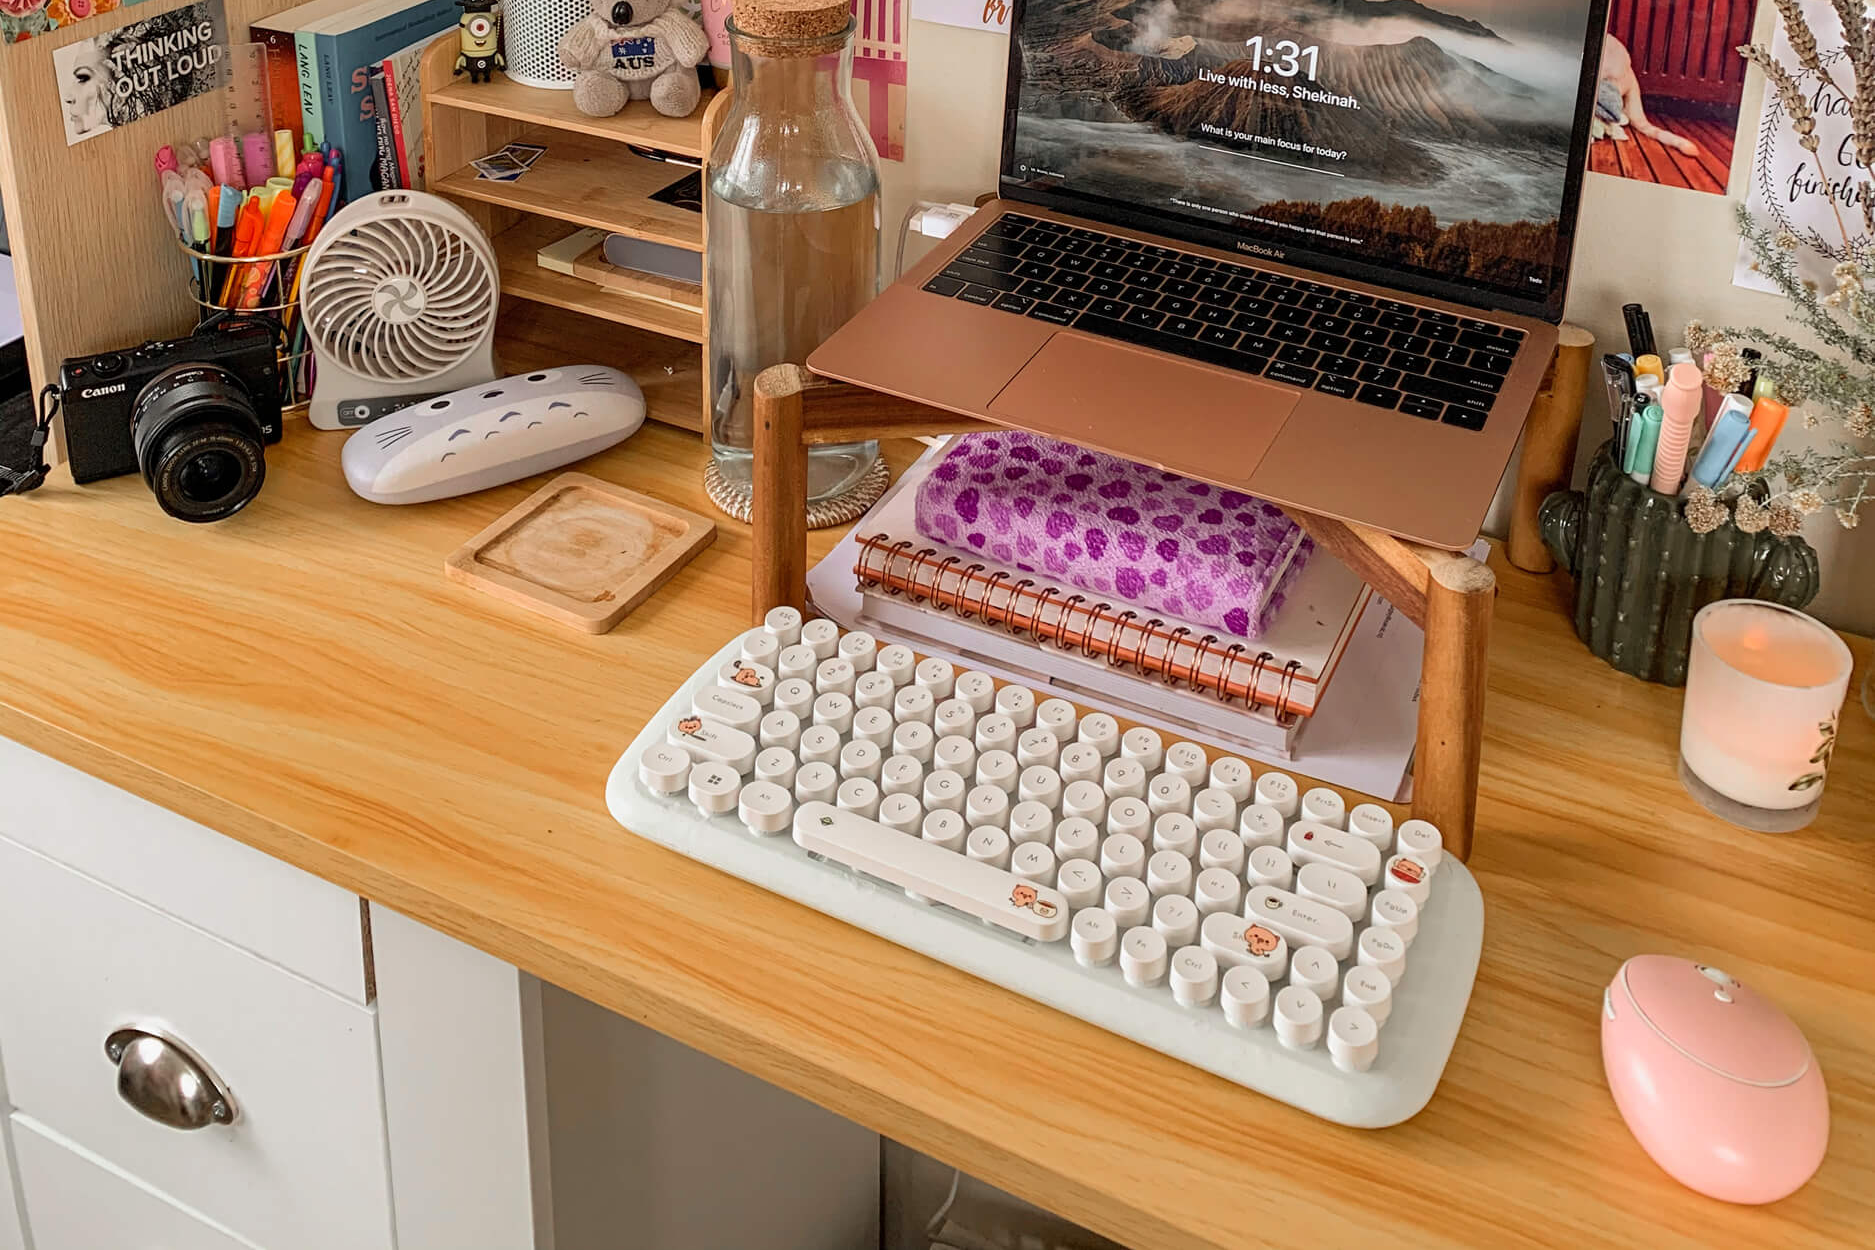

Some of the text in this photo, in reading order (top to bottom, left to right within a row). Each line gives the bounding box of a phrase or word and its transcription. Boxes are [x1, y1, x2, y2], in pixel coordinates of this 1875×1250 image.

[111, 21, 213, 73] THINKING
[269, 35, 277, 45] 6
[1245, 35, 1320, 82] 1:31
[116, 44, 222, 98] OUT LOUD
[298, 43, 314, 116] LANG LEAV
[612, 56, 655, 70] AUS
[1198, 68, 1361, 110] Live with less, Shekinah.
[1200, 122, 1348, 160] What is your main focus for today?
[1236, 241, 1286, 259] MacBook Air
[81, 383, 126, 399] Canon
